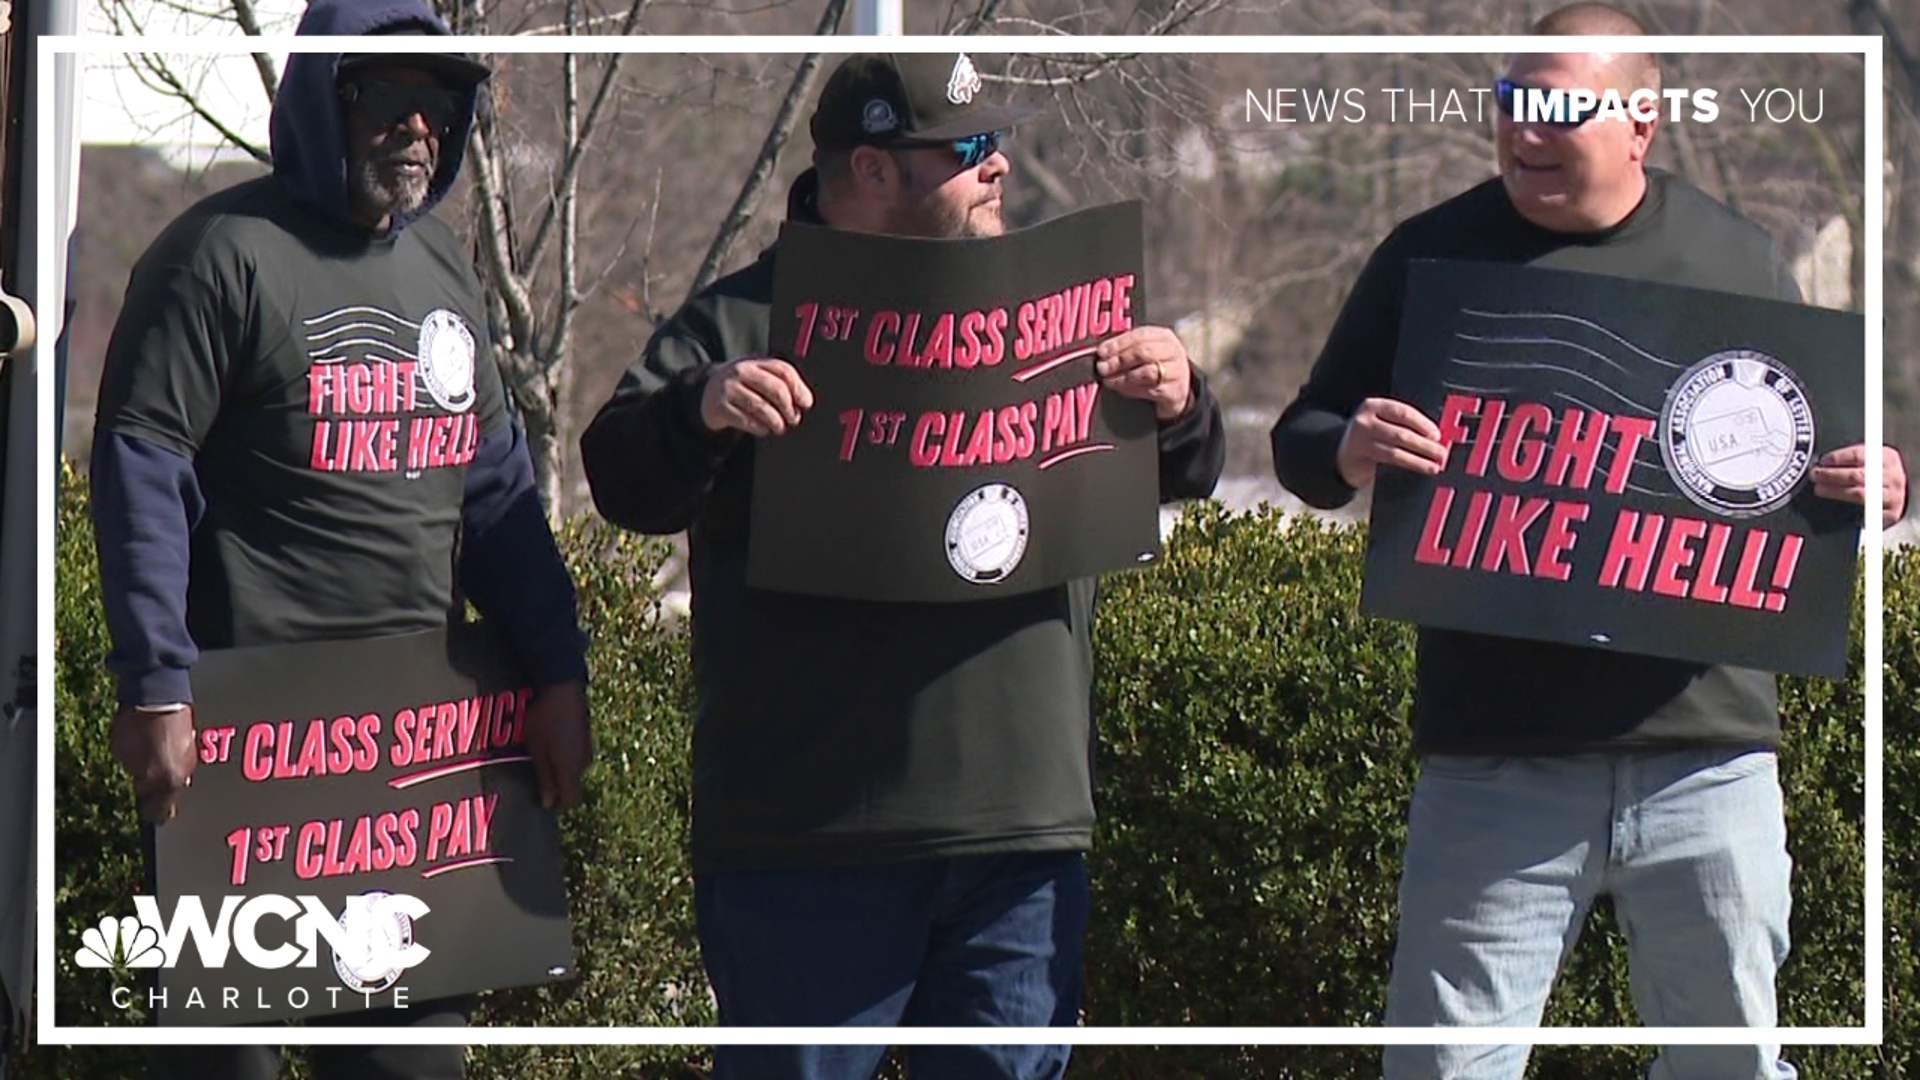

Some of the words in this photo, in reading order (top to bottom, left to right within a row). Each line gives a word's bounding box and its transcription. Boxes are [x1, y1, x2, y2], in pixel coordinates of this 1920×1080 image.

[793, 302, 859, 359] 1ST
[863, 305, 1008, 369] CLASS
[1014, 273, 1135, 360] SERVICE
[309, 362, 418, 414] FIGHT
[838, 407, 906, 463] 1ST
[909, 401, 1037, 468] CLASS
[1041, 382, 1099, 452] PAY
[310, 420, 399, 472] LIKE
[1436, 393, 1656, 495] FIGHT
[1414, 486, 1590, 582] LIKE
[1599, 508, 1804, 612] HELL!
[190, 726, 235, 765] ST
[241, 713, 381, 782] CLASS
[226, 825, 290, 886] 1ST
[294, 810, 419, 880] CLASS
[427, 794, 499, 862] PAY
